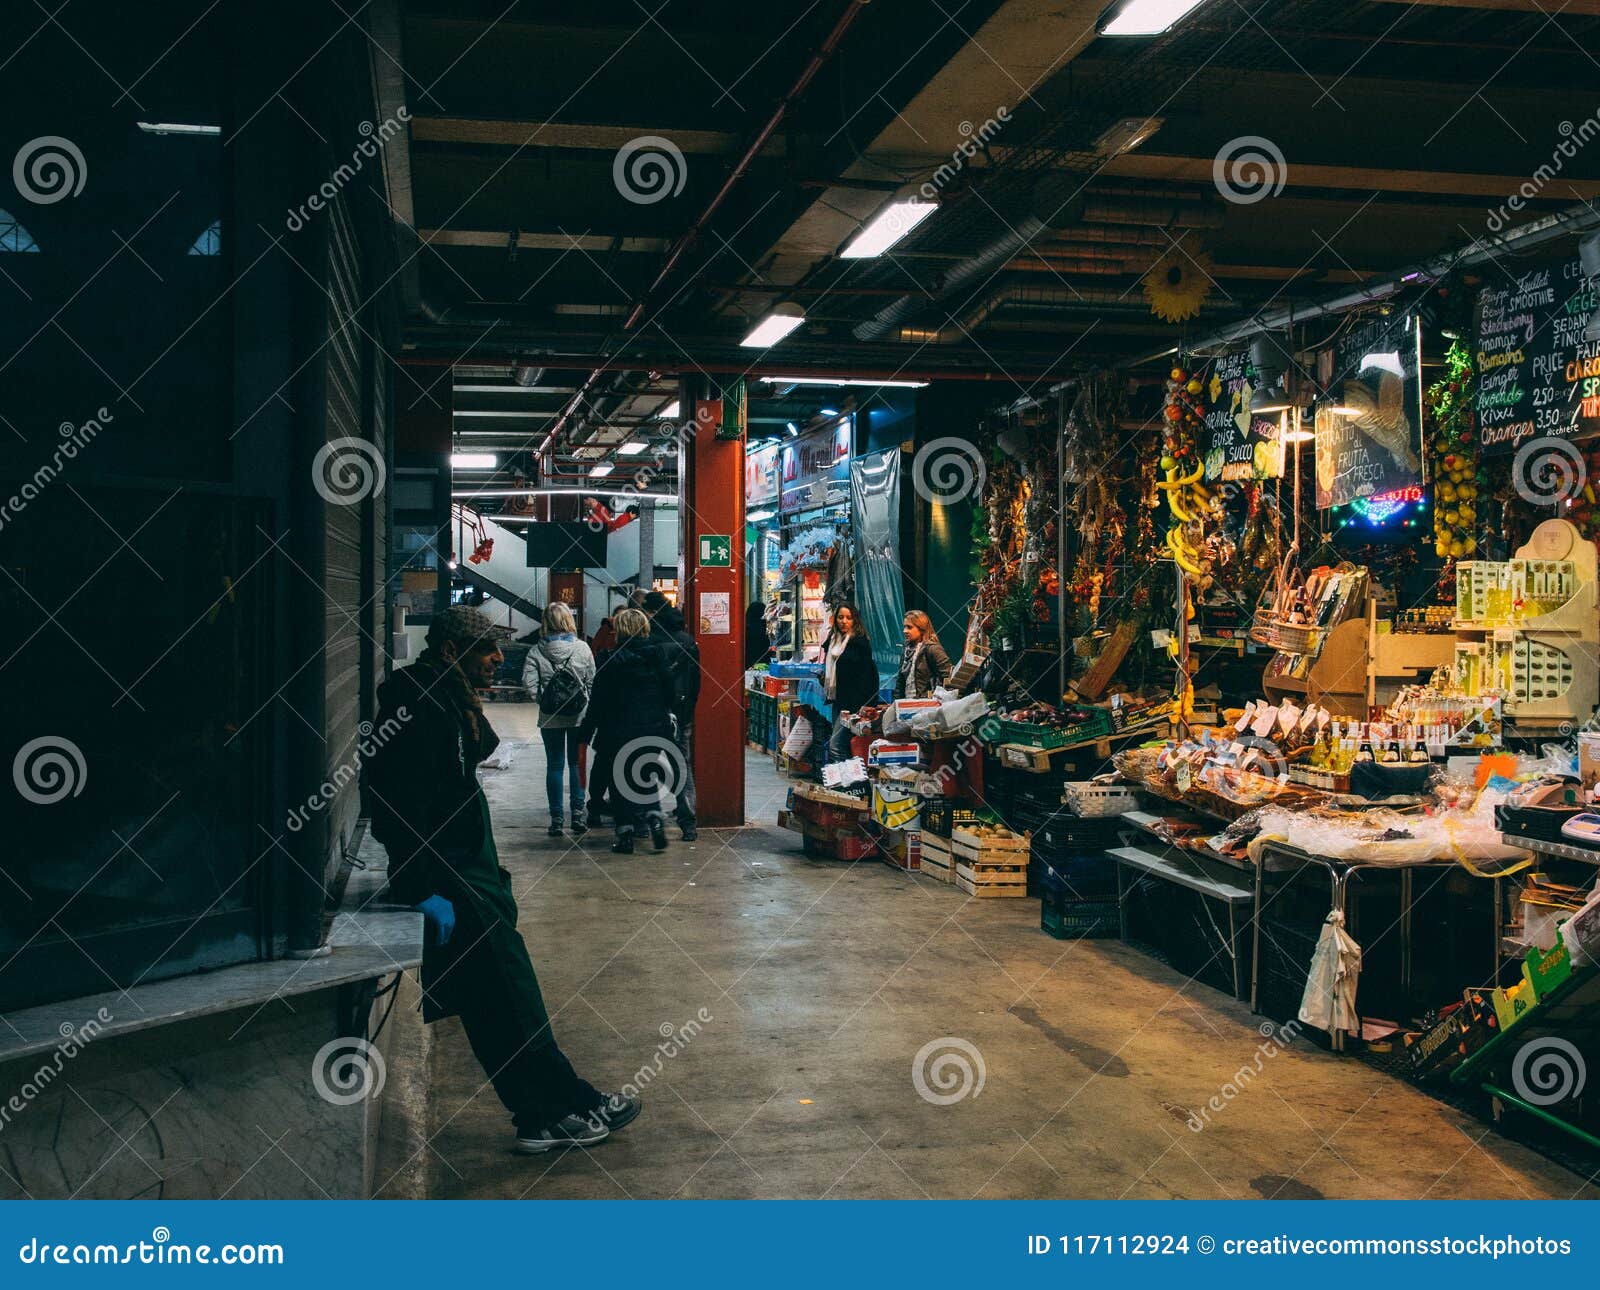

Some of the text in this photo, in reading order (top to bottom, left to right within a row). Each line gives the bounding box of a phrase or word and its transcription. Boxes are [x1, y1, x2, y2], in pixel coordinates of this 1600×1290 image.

[1532, 352, 1565, 378] PRICE
[1481, 420, 1536, 448] Oranges
[1229, 443, 1254, 463] SUCCO
[1337, 448, 1370, 470] FRUTTA
[1352, 463, 1386, 483] FRESCA
